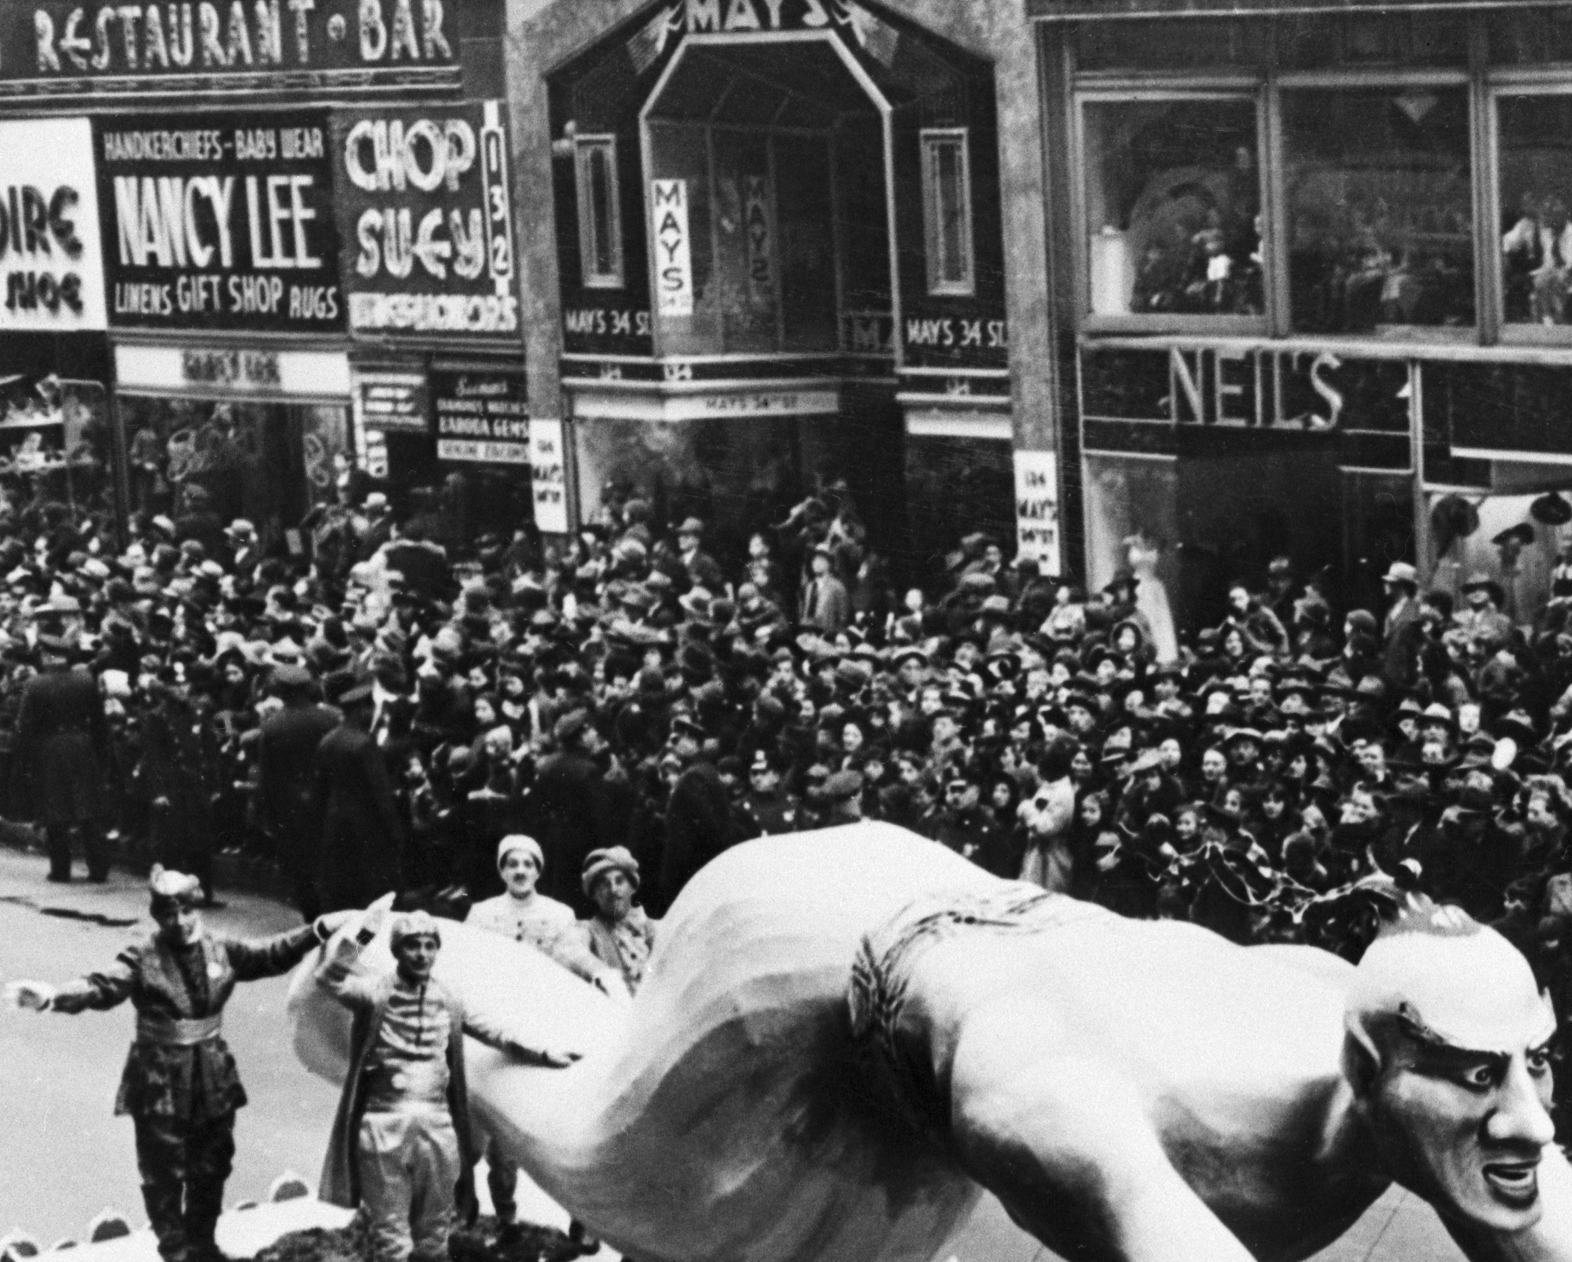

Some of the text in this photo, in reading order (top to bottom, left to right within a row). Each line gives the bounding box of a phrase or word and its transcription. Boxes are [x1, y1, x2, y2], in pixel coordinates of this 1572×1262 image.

[34, 0, 452, 71] RESTAURANT BAR
[235, 128, 276, 160] BABY
[280, 127, 324, 159] WEAR
[344, 119, 476, 192] CHOP
[113, 174, 323, 268] NANCY LEE
[356, 207, 484, 280] SUEY
[653, 182, 685, 293] MAYS
[176, 275, 221, 313] GIFT
[228, 274, 284, 314] SHOP
[289, 285, 338, 320] RUGS
[960, 319, 982, 346] 34
